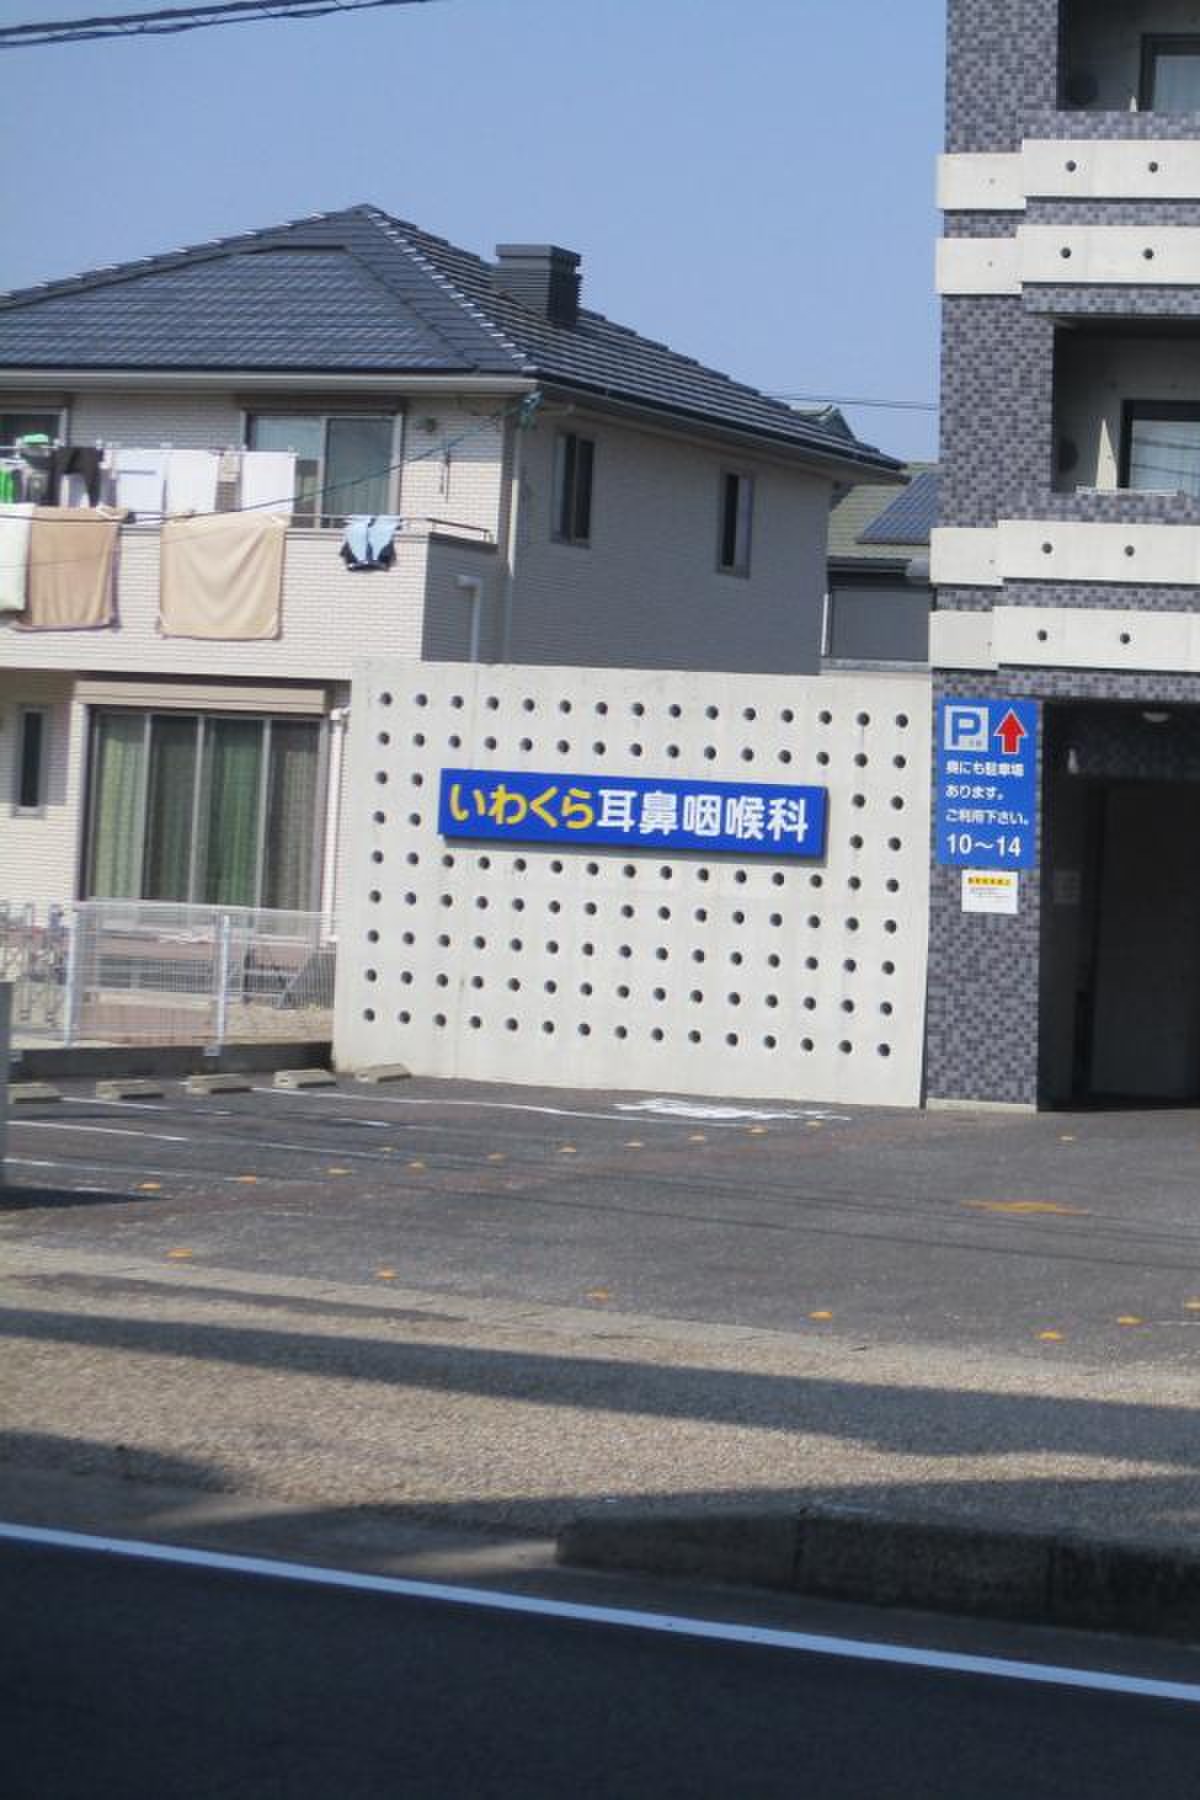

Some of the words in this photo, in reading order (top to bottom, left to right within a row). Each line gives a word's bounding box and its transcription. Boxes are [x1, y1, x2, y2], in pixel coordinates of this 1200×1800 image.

[951, 711, 981, 747] P
[449, 783, 809, 843] いわくら耳鼻咽喉科
